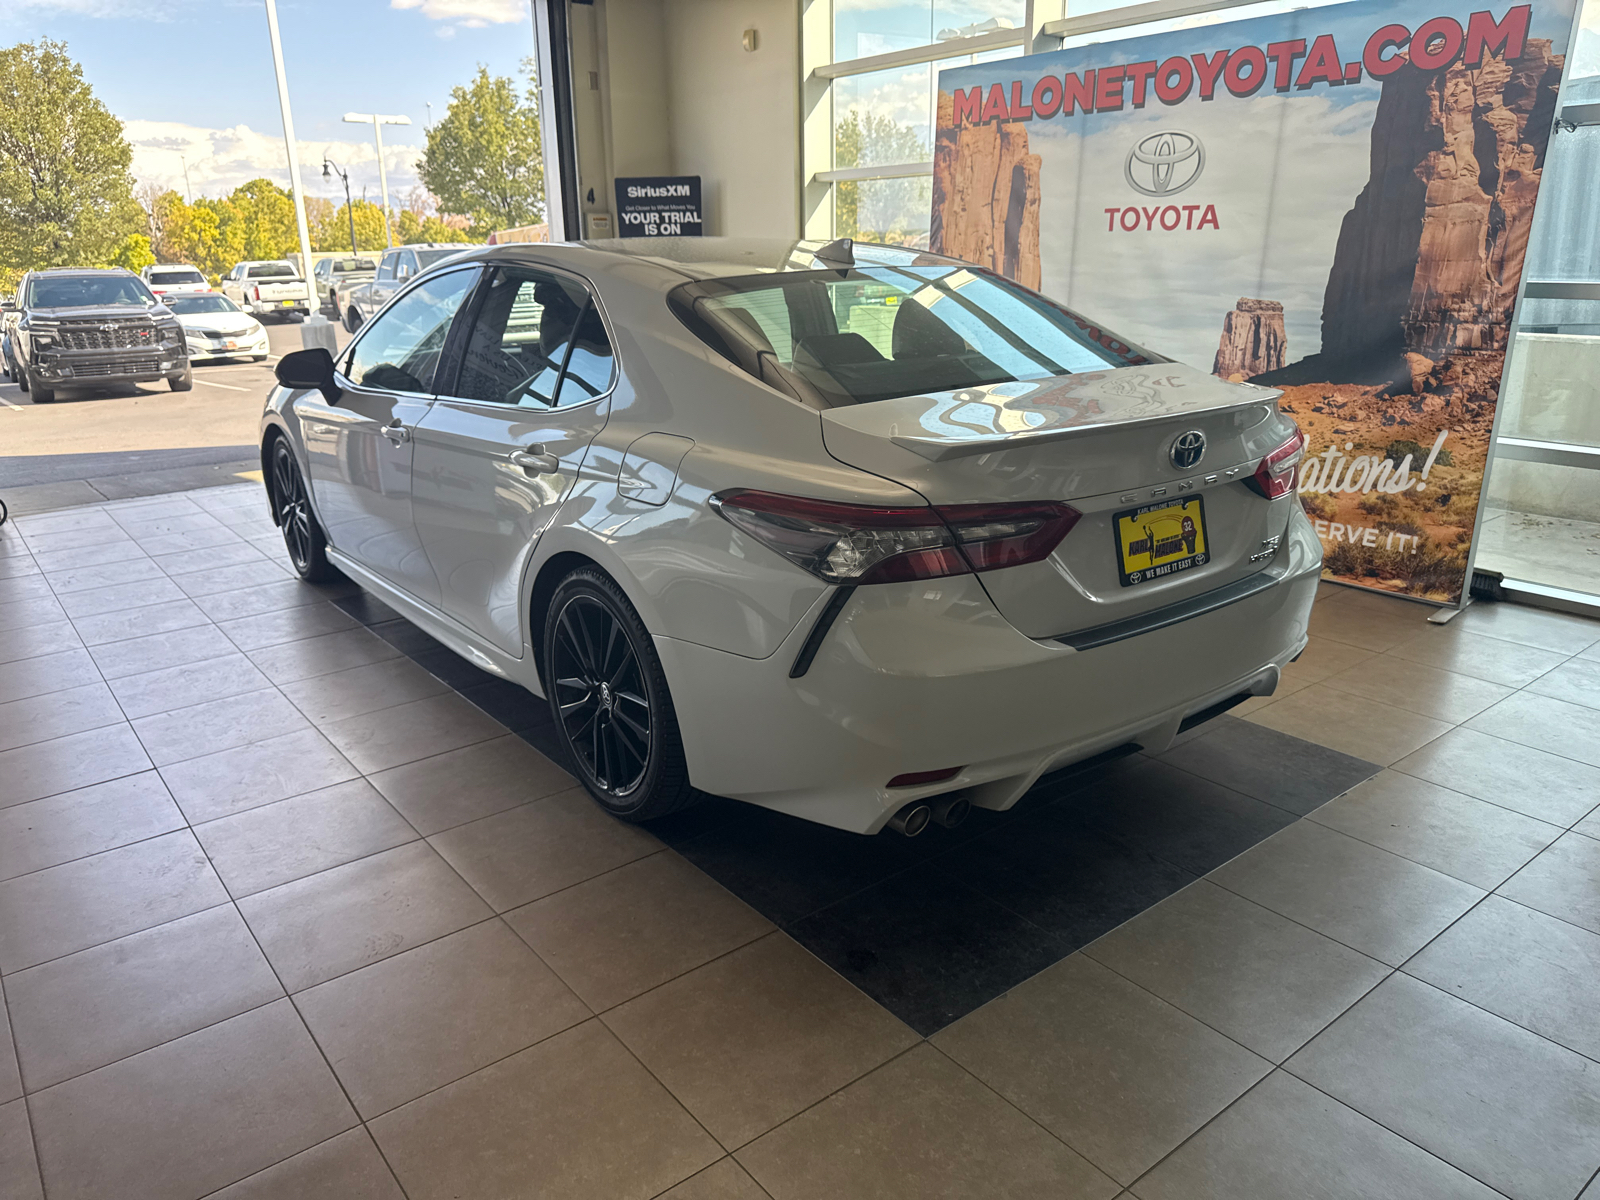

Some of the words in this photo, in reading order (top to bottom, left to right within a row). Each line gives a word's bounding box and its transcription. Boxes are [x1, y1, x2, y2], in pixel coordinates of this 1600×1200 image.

[952, 4, 1532, 127] MALONETOYOTA.COM
[586, 187, 596, 206] 4
[627, 185, 690, 198] SiriusXM
[621, 212, 660, 225] YOUR
[661, 211, 702, 223] TRIAL
[1104, 204, 1220, 233] TOYOTA
[644, 224, 658, 236] IS
[660, 223, 681, 235] ON
[1298, 429, 1448, 494] ations!
[1120, 468, 1239, 504] CAMRY
[1183, 521, 1192, 532] 32
[1308, 519, 1379, 548] ERVE
[1386, 532, 1419, 555] IT!
[1145, 570, 1155, 579] WE
[1155, 565, 1172, 575] MAKE
[1171, 563, 1178, 572] IT
[1178, 558, 1192, 569] EASY
